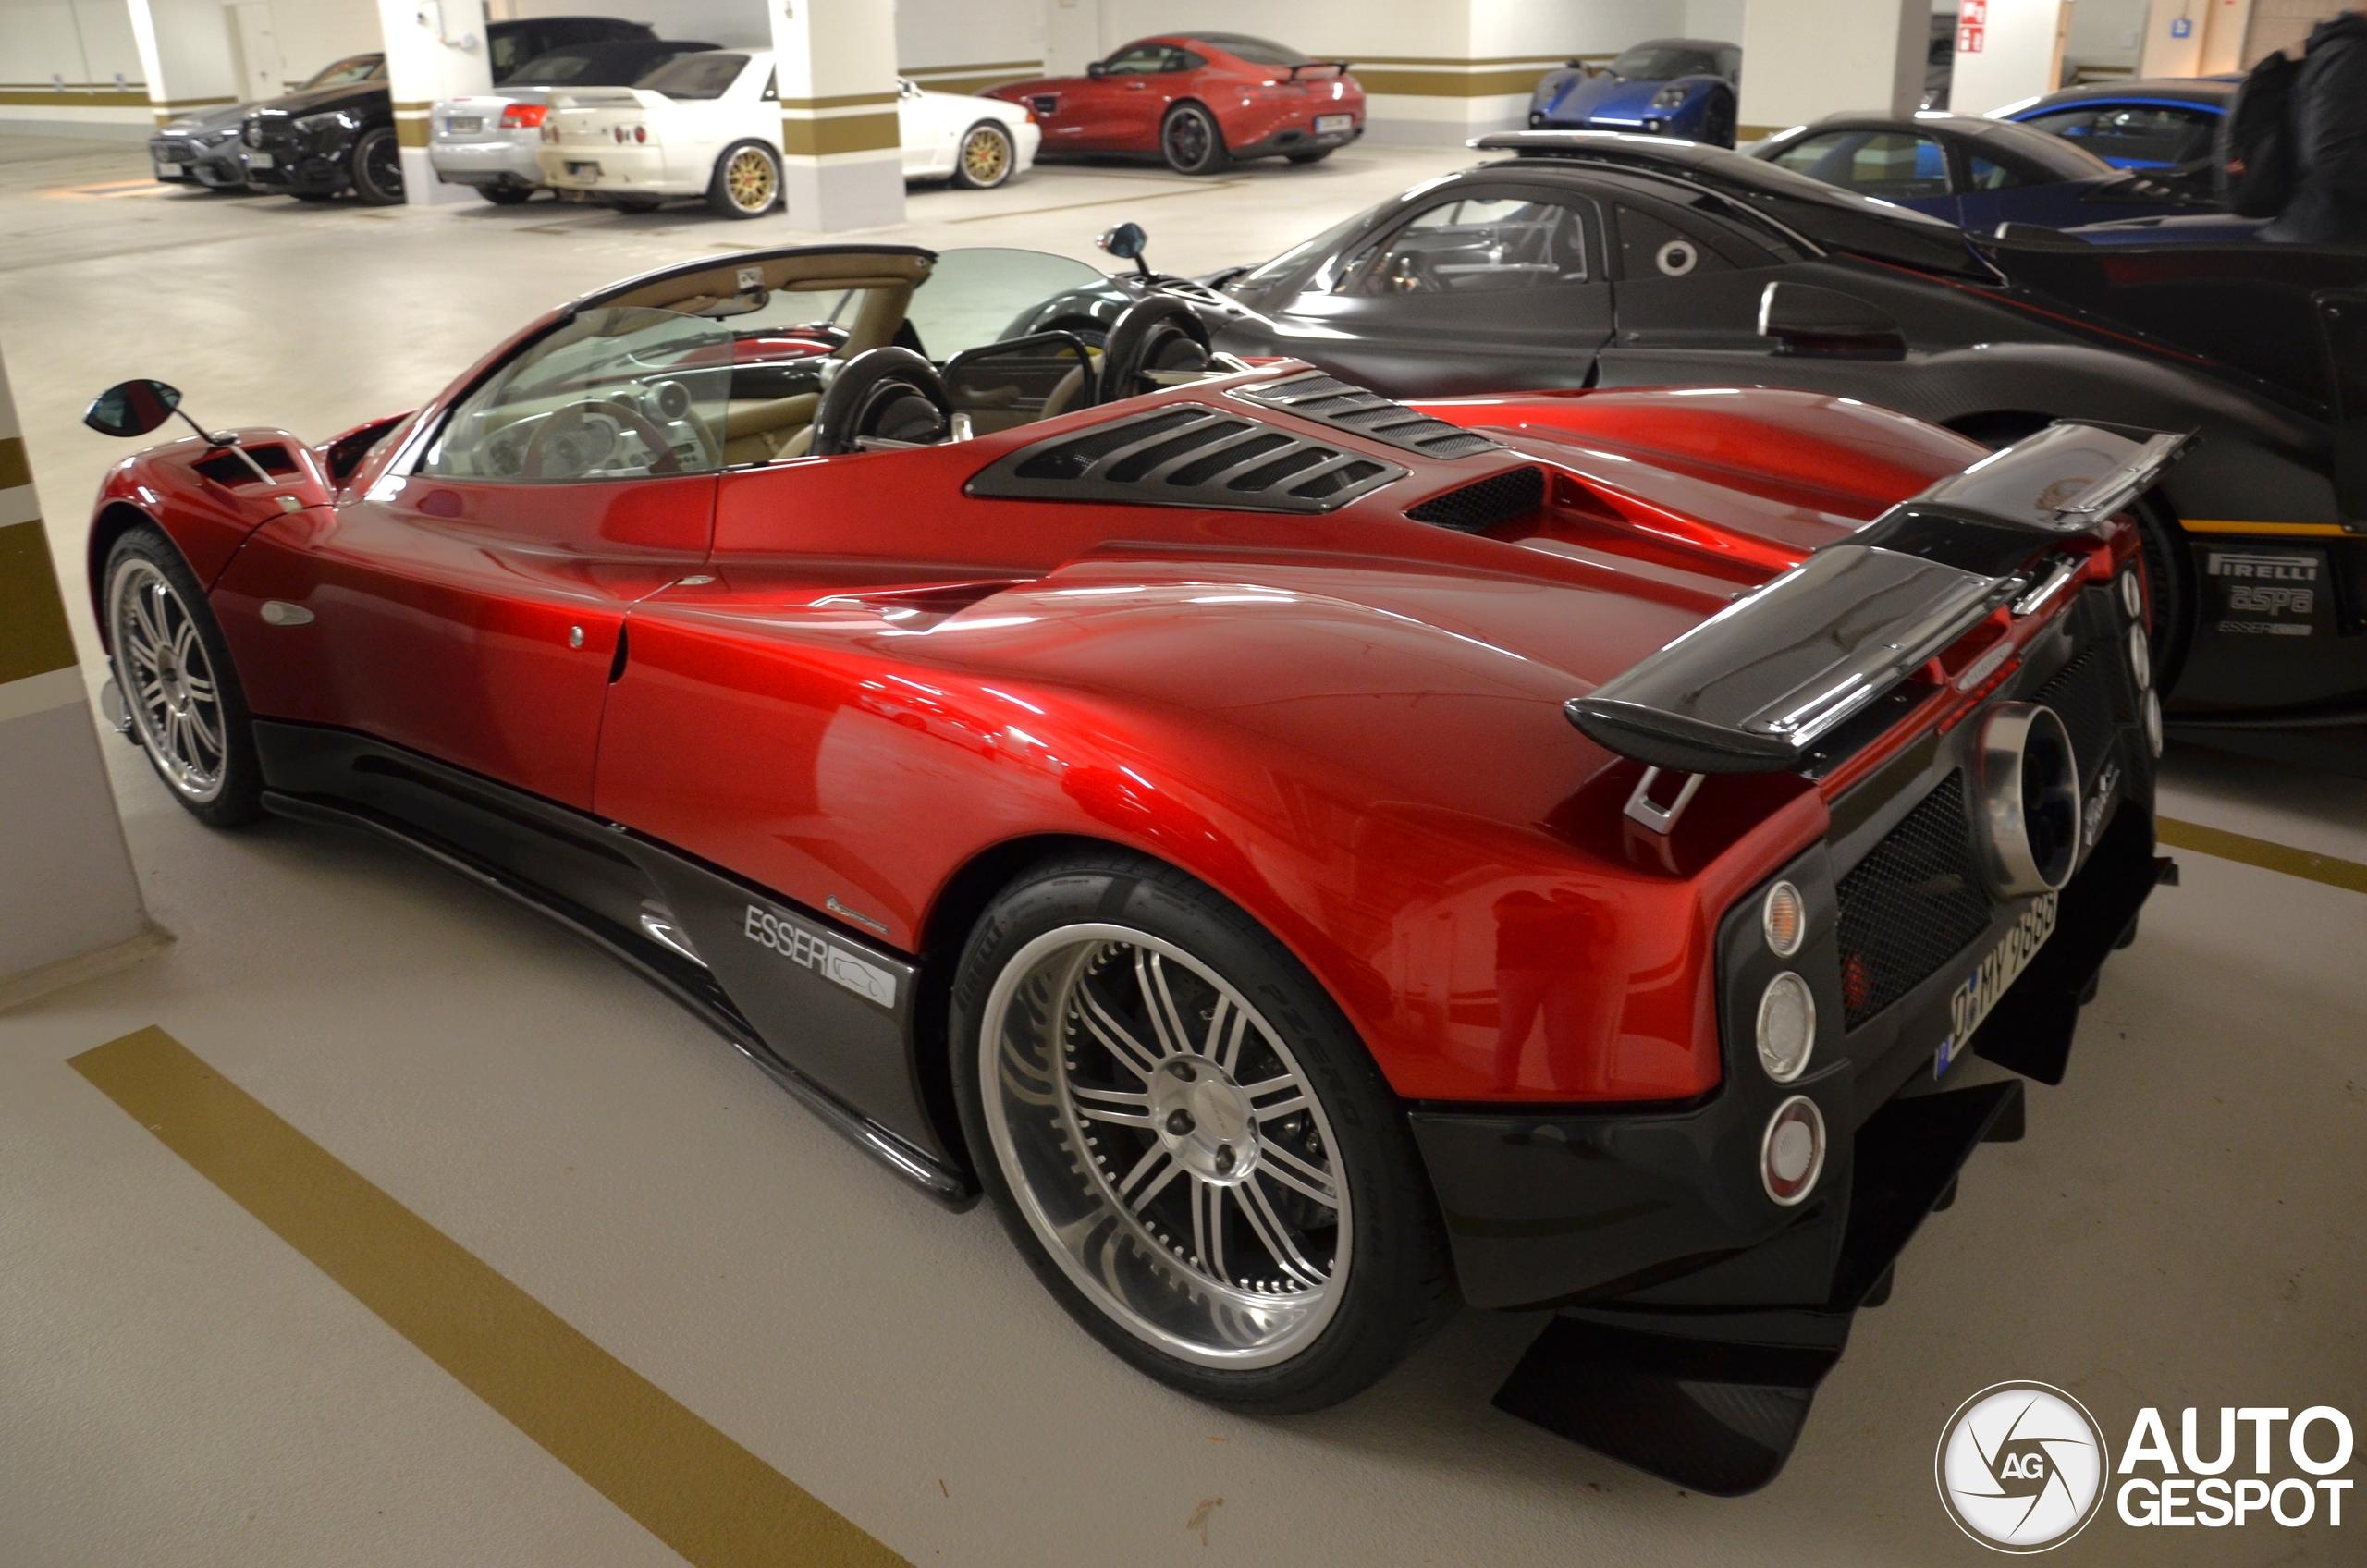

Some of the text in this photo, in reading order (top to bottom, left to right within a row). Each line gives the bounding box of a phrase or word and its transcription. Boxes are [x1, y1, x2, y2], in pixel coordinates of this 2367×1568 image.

[2208, 553, 2319, 581] PIRELLI
[2230, 586, 2312, 616] aspa
[2220, 622, 2273, 633] ESSER
[744, 904, 828, 977] ESSER
[955, 915, 1003, 1012] PIRELLI
